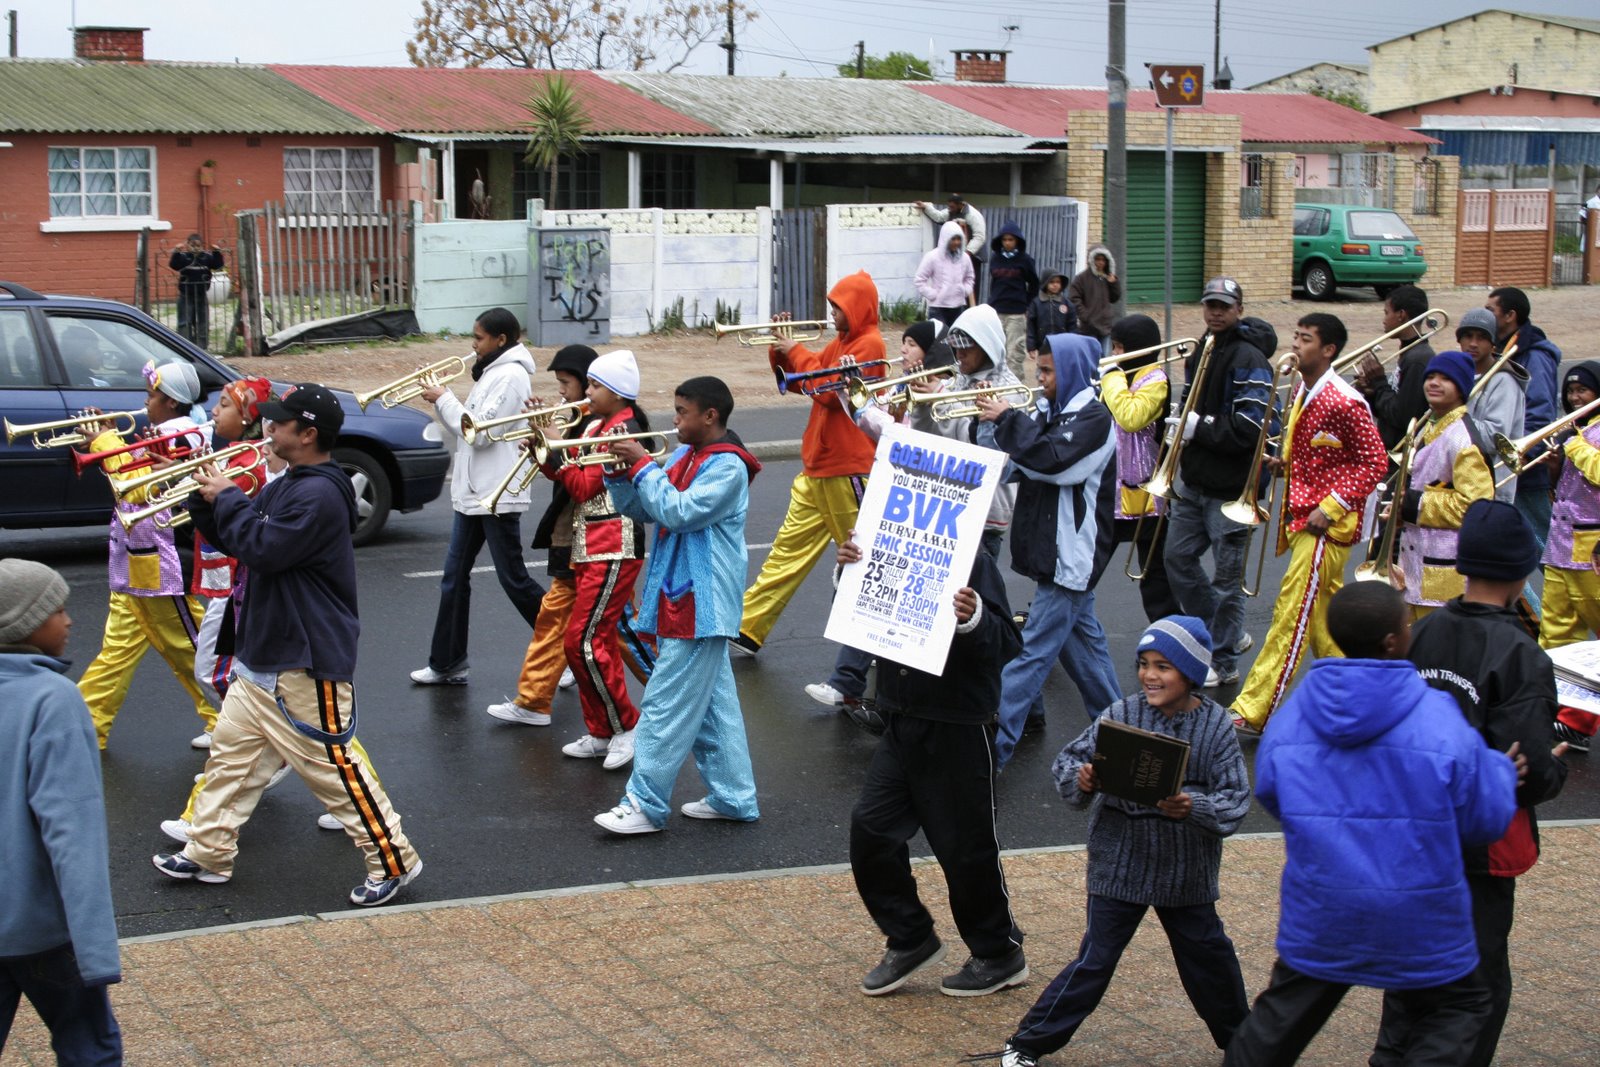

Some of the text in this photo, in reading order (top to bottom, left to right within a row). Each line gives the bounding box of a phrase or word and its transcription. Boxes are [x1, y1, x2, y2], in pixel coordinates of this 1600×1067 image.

[893, 473, 971, 504] YOU ARE WELCOME
[882, 485, 967, 540] BVK
[879, 520, 957, 551] BURNI AMAN
[871, 548, 909, 570] WED
[879, 533, 902, 553] MIC
[903, 541, 953, 569] SESSION
[864, 562, 885, 582] 25
[910, 561, 950, 583] SAT
[861, 579, 899, 603] 12-2PM
[903, 574, 925, 595] 28
[856, 600, 868, 609] CAPE
[868, 603, 882, 612] TOWN
[858, 594, 895, 610] CHURCH SQUARE
[899, 593, 939, 616] 3:30PM
[895, 613, 912, 624] TOWN
[912, 619, 933, 632] CENTRE
[1439, 668, 1481, 704] TRANSPORT
